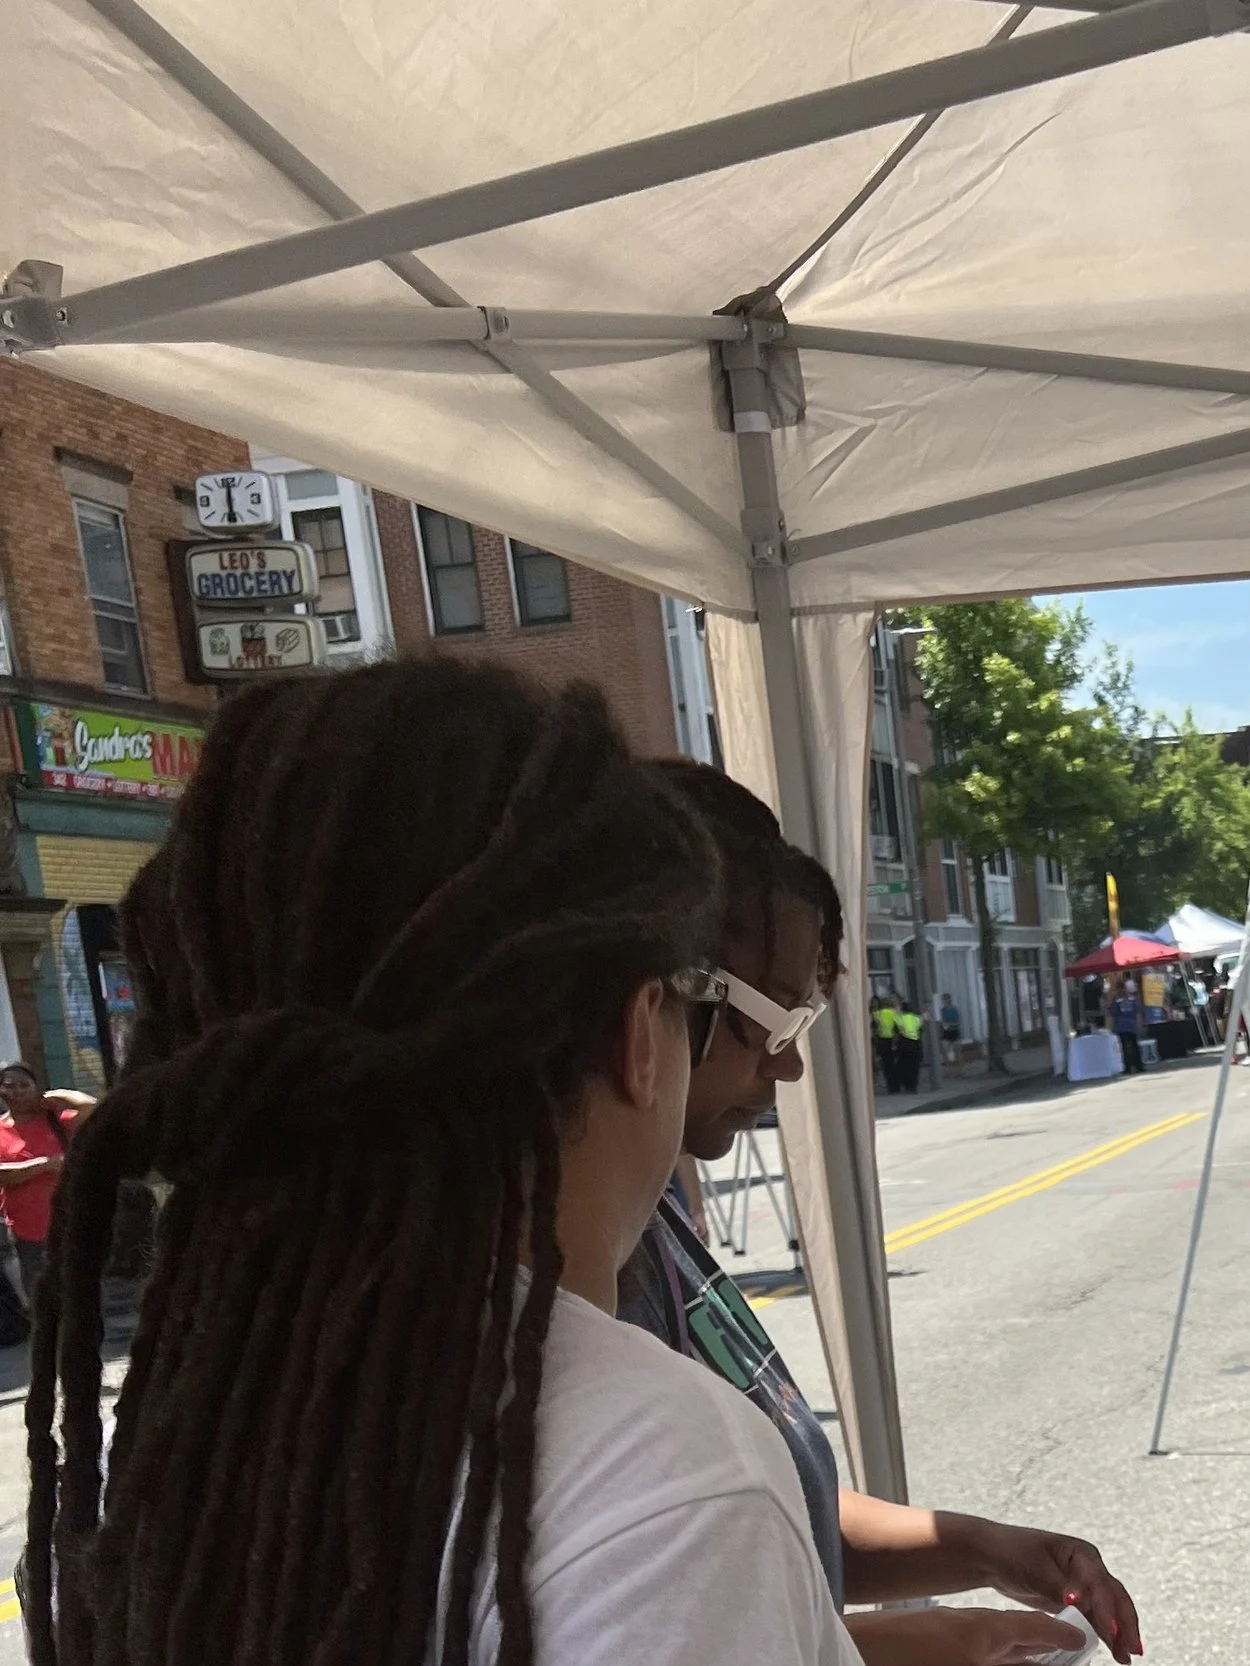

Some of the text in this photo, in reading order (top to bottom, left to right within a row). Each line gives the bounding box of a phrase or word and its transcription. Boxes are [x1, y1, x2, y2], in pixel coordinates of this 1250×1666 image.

[219, 551, 267, 571] LEO'S
[197, 569, 296, 597] GROCERY
[152, 732, 202, 780] MA
